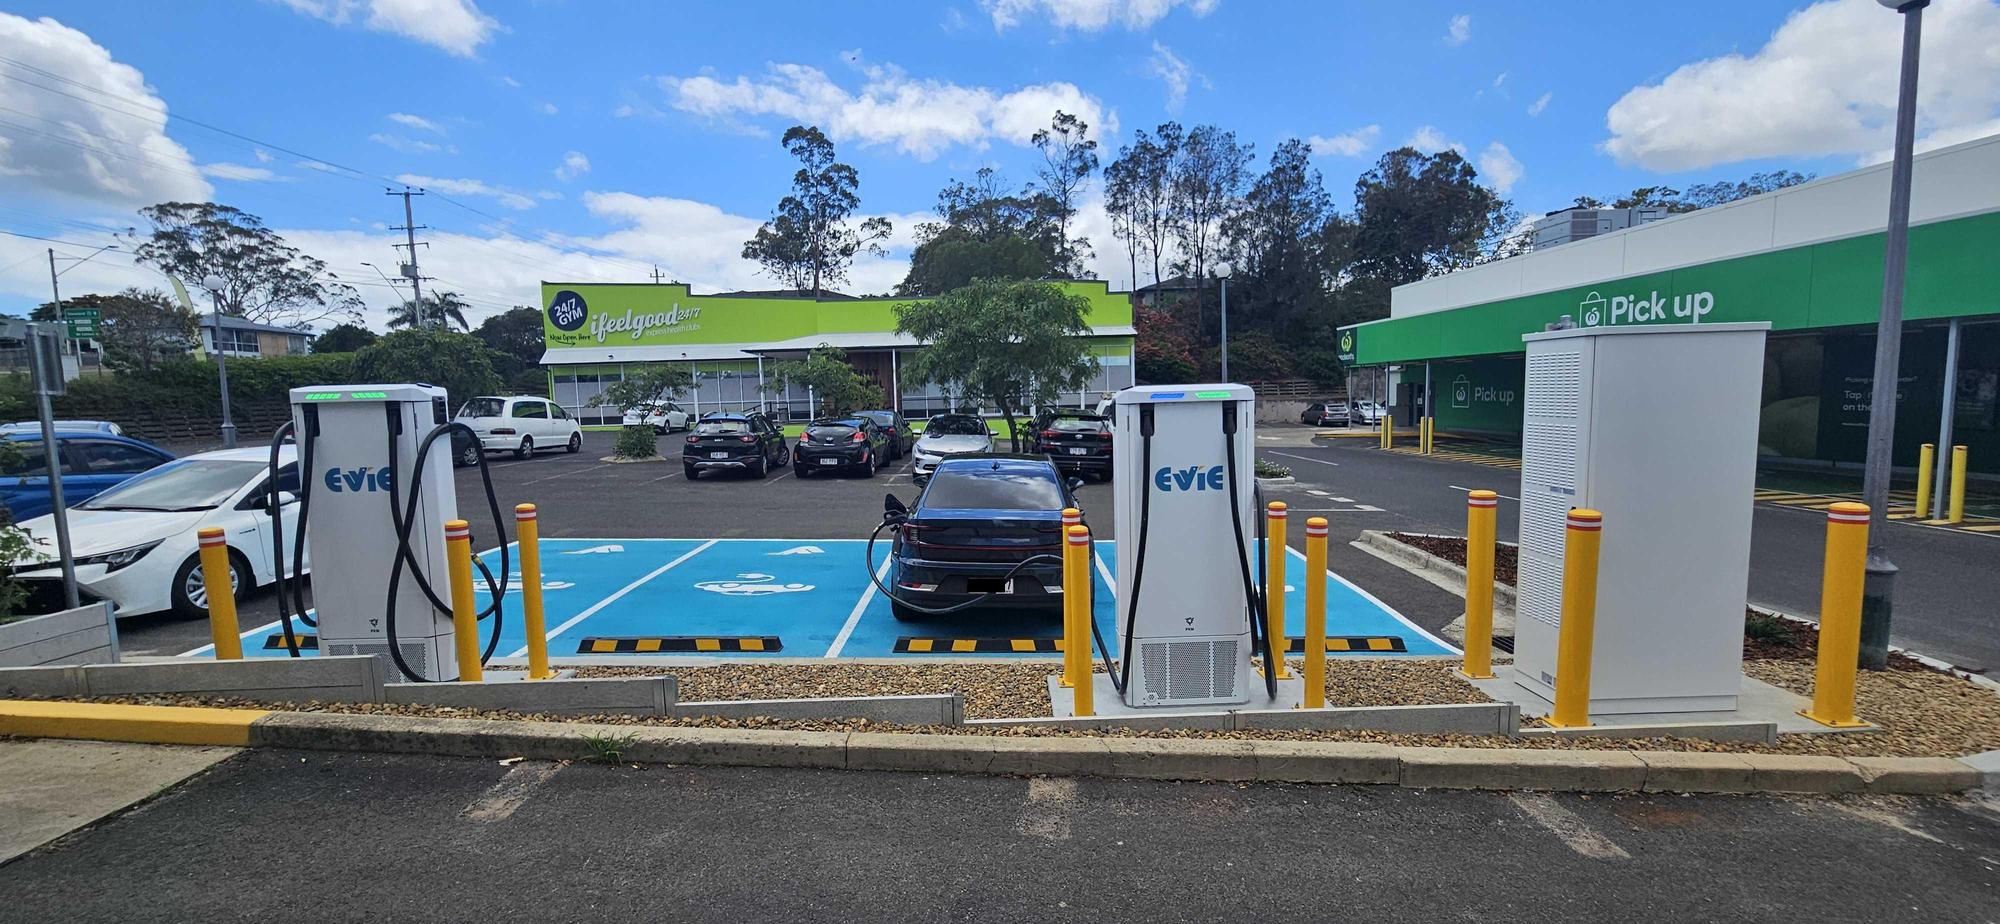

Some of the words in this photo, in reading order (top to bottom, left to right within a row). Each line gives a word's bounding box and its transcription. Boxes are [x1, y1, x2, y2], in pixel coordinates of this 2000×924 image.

[554, 298, 577, 316] 24/7
[558, 306, 583, 326] GYM
[1611, 291, 1666, 324] Pick
[1673, 291, 1714, 324] up
[590, 303, 679, 343] ifeelgood
[677, 307, 700, 320] 24/7
[1474, 386, 1496, 401] Pick
[1499, 390, 1514, 406] up
[1843, 390, 1862, 401] Tap
